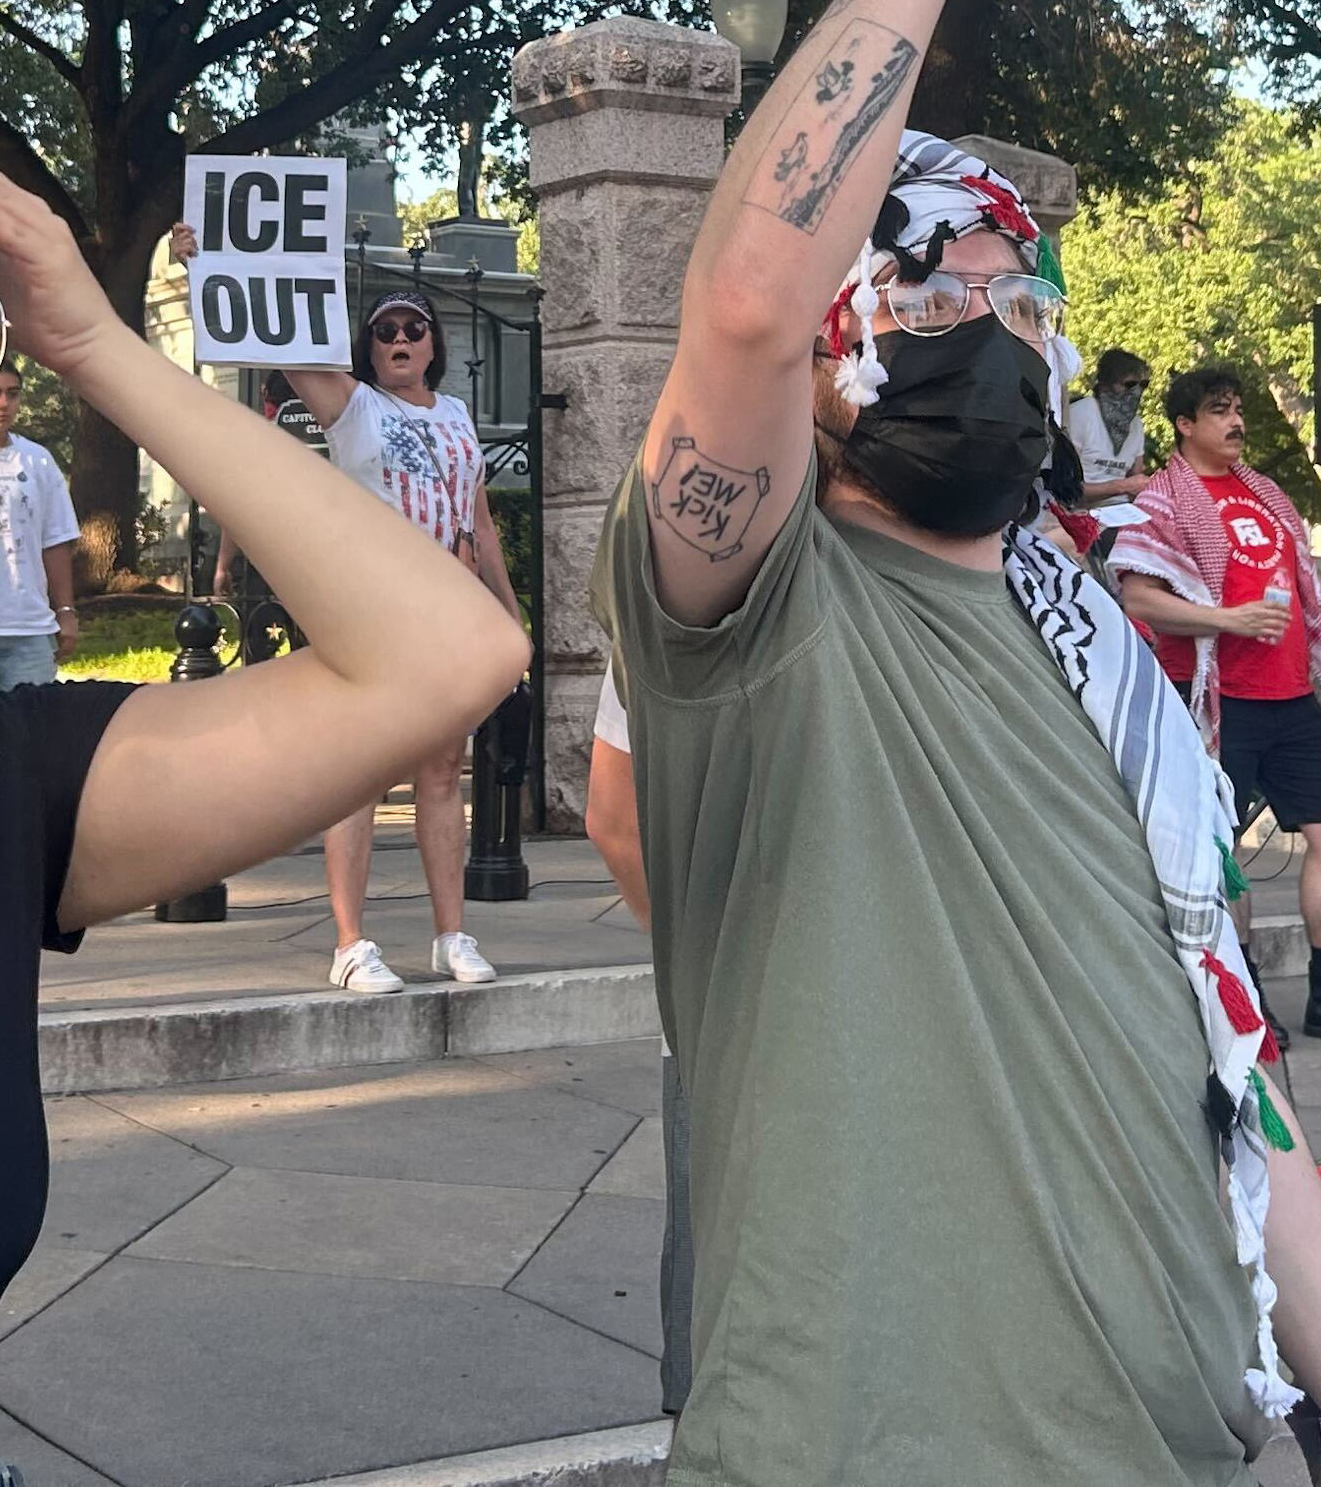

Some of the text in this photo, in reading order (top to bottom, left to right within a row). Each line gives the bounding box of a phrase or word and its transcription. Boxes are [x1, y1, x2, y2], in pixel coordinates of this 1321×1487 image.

[203, 171, 328, 253] ICE
[202, 274, 337, 346] OUT
[680, 464, 747, 507] ME!
